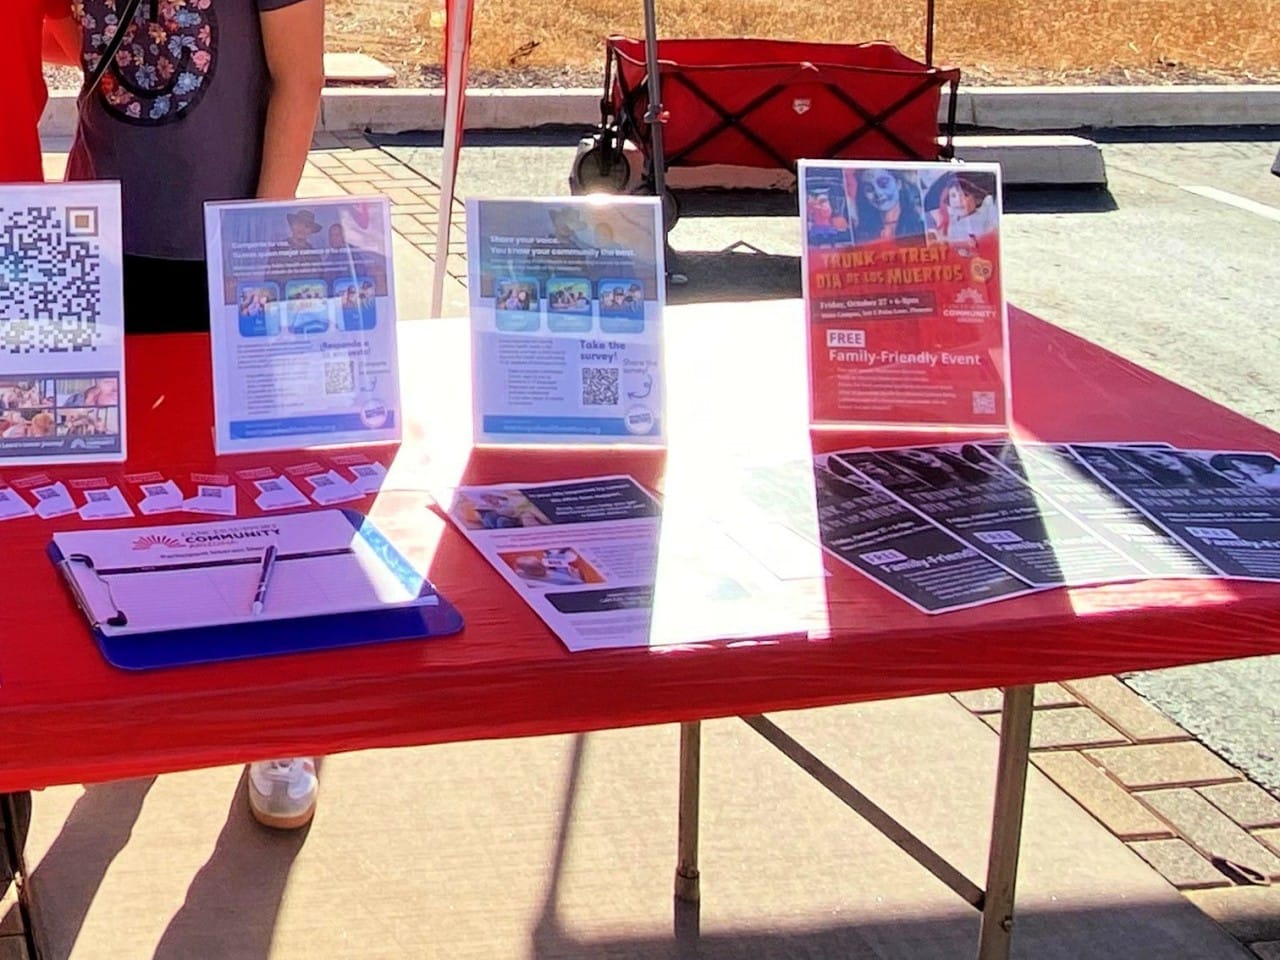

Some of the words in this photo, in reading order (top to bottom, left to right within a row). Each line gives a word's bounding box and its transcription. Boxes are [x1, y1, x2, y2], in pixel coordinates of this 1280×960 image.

[516, 237, 535, 245] your
[508, 247, 530, 255] know
[531, 248, 550, 257] your
[551, 248, 600, 258] community
[601, 248, 615, 256] the
[899, 246, 950, 265] TREAT
[887, 264, 964, 286] MUERTOS
[820, 300, 847, 310] Friday,
[847, 298, 876, 309] October
[943, 309, 997, 318] COMMUNITY
[829, 332, 862, 345] FREE
[580, 340, 607, 350] Take
[608, 341, 626, 350] the
[580, 352, 618, 363] survey!
[829, 350, 937, 367] Family-Friendly
[941, 352, 982, 365] Event
[184, 528, 281, 544] COMMUNITY
